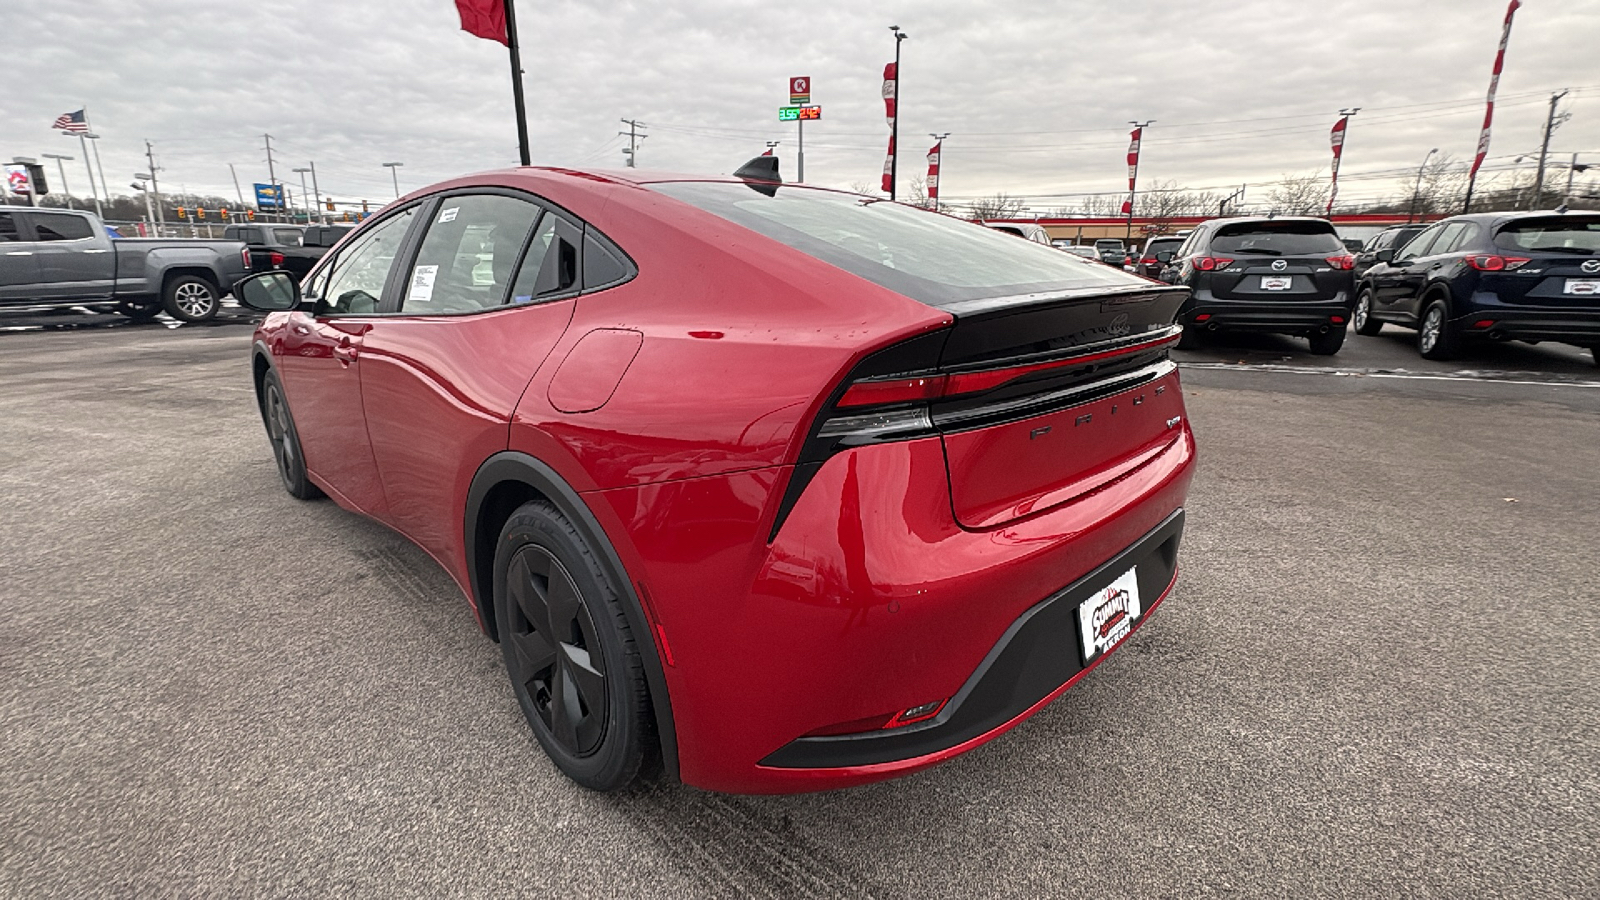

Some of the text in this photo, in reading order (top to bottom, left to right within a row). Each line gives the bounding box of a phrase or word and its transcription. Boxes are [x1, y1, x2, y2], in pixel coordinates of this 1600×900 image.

[1030, 385, 1165, 440] PRIUS
[1092, 590, 1129, 641] SUMMIT
[1102, 622, 1131, 654] AKRON
